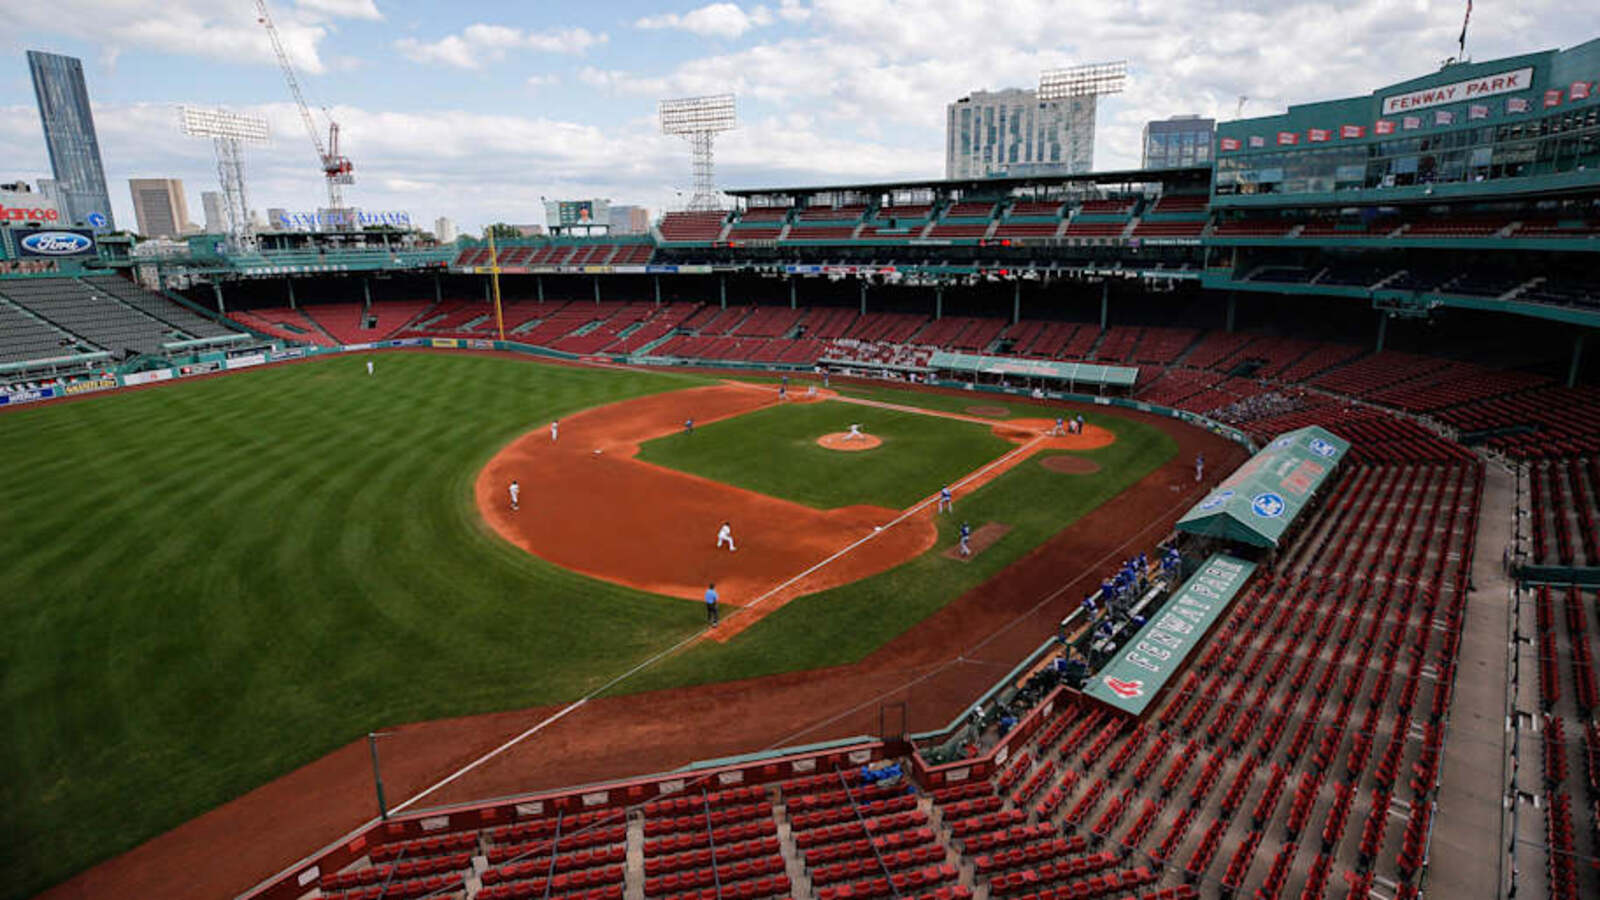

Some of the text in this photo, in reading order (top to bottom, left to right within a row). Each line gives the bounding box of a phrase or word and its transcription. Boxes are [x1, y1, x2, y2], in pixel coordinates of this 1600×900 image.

[1390, 74, 1518, 110] FENWAY PARK
[357, 210, 411, 225] ADAMS
[37, 232, 78, 250] Ford
[1125, 558, 1244, 672] FENWAY PARK
